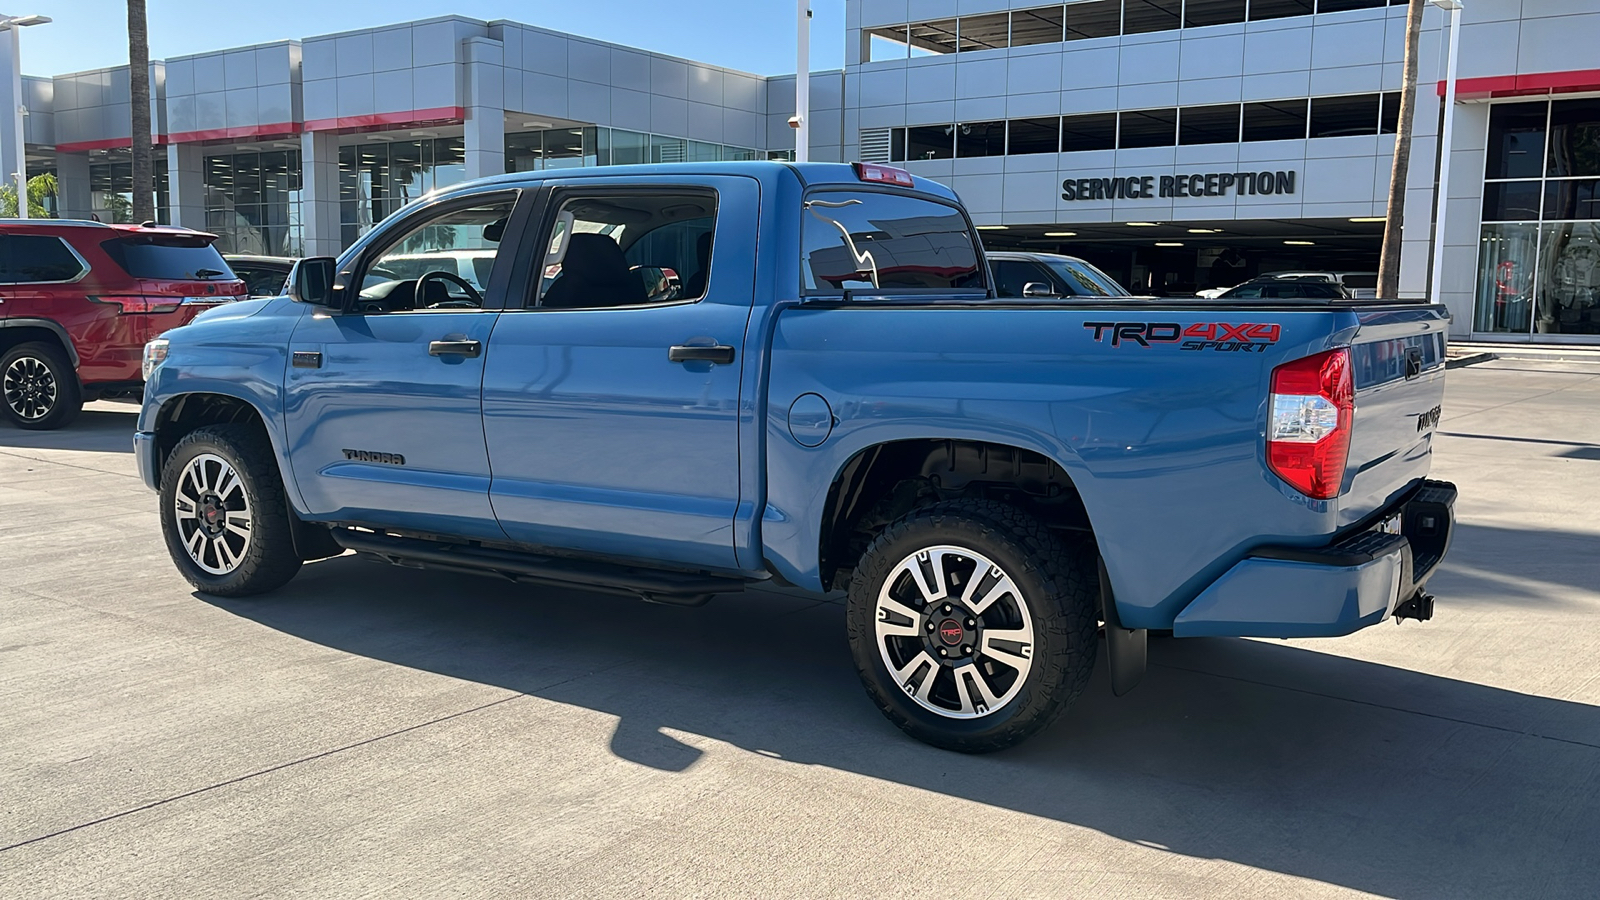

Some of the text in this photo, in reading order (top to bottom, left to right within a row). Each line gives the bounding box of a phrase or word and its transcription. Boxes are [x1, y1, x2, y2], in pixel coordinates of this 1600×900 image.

[1061, 170, 1296, 201] SERVICE RECEPTION
[1179, 340, 1276, 353] SPORT
[341, 448, 407, 465] TUNDRA
[941, 628, 962, 637] TRD
